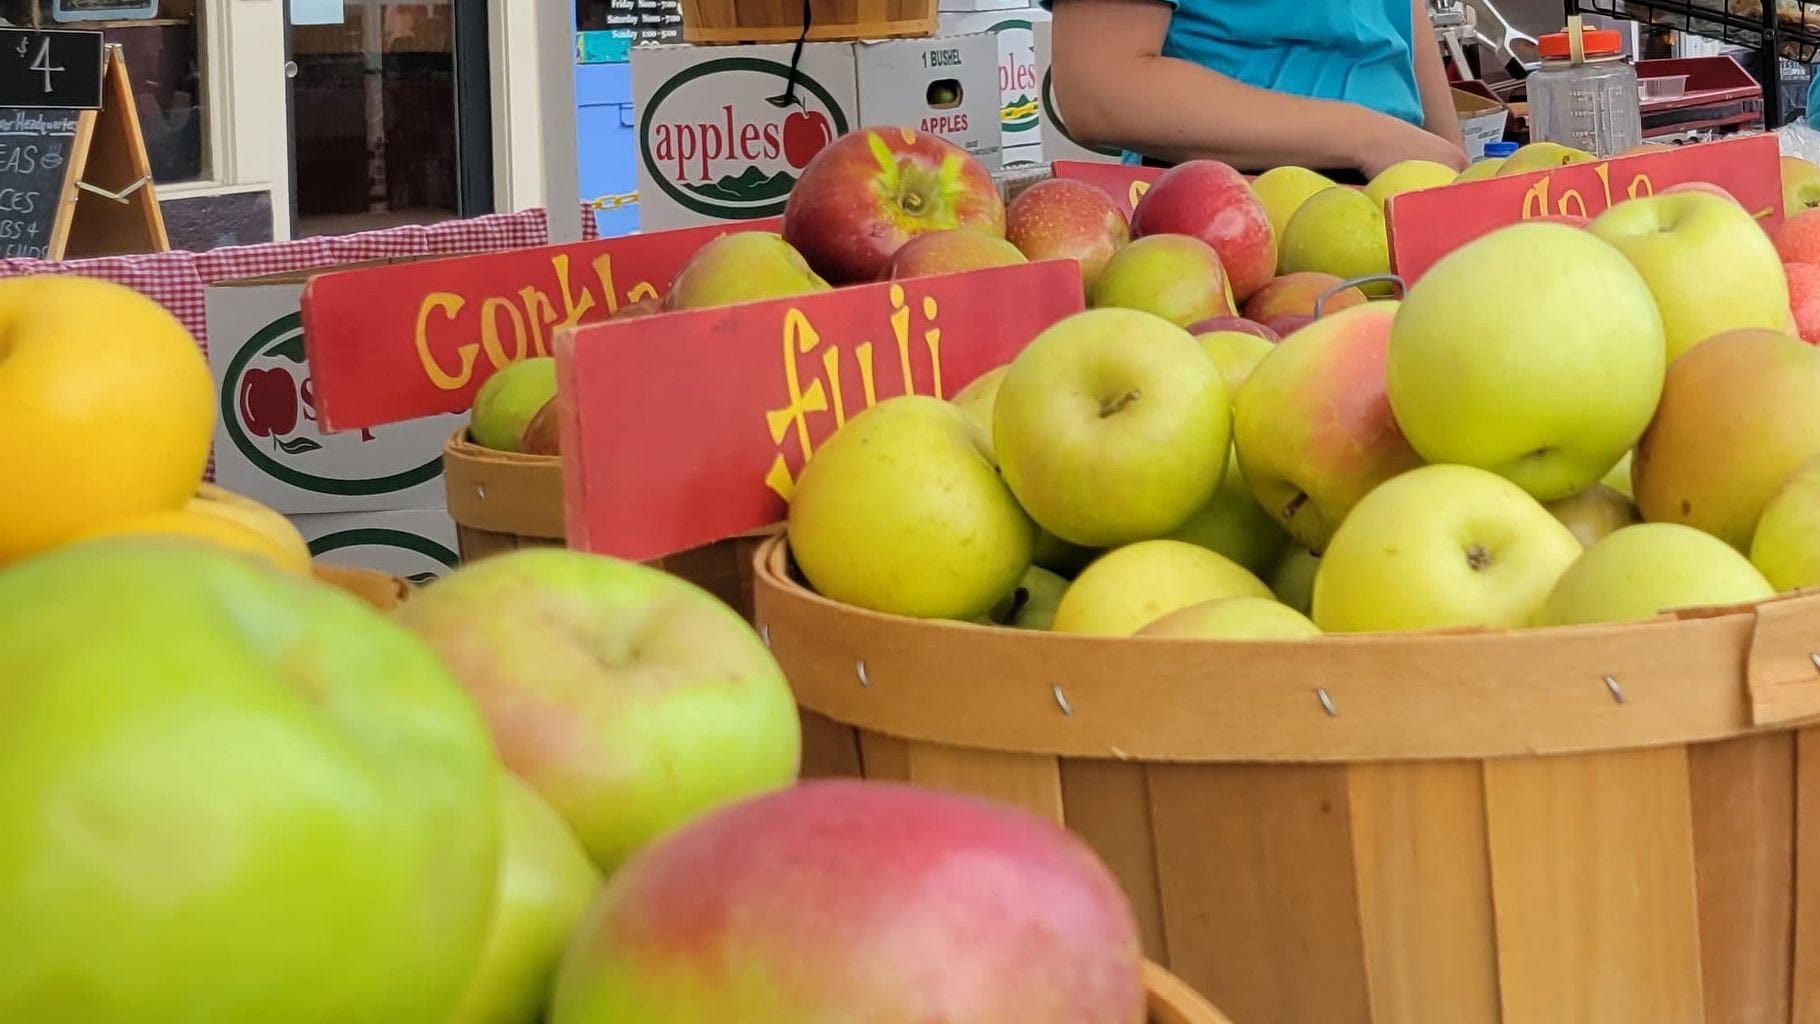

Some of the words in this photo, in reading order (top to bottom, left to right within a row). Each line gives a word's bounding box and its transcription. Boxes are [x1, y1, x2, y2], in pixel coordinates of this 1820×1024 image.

[611, 0, 634, 10] Friday
[638, 0, 656, 8] Noon
[661, 1, 677, 9] 7:00
[607, 15, 638, 25] Saturday
[642, 14, 660, 23] Noon
[611, 29, 637, 40] Sunday
[661, 30, 677, 39] 5:00
[15, 37, 66, 93] $4
[922, 51, 928, 68] 1
[930, 49, 962, 67] BUSHEL
[998, 52, 1036, 91] ples
[921, 114, 969, 134] APPLES
[655, 105, 781, 181] apples
[765, 284, 941, 503] fuji
